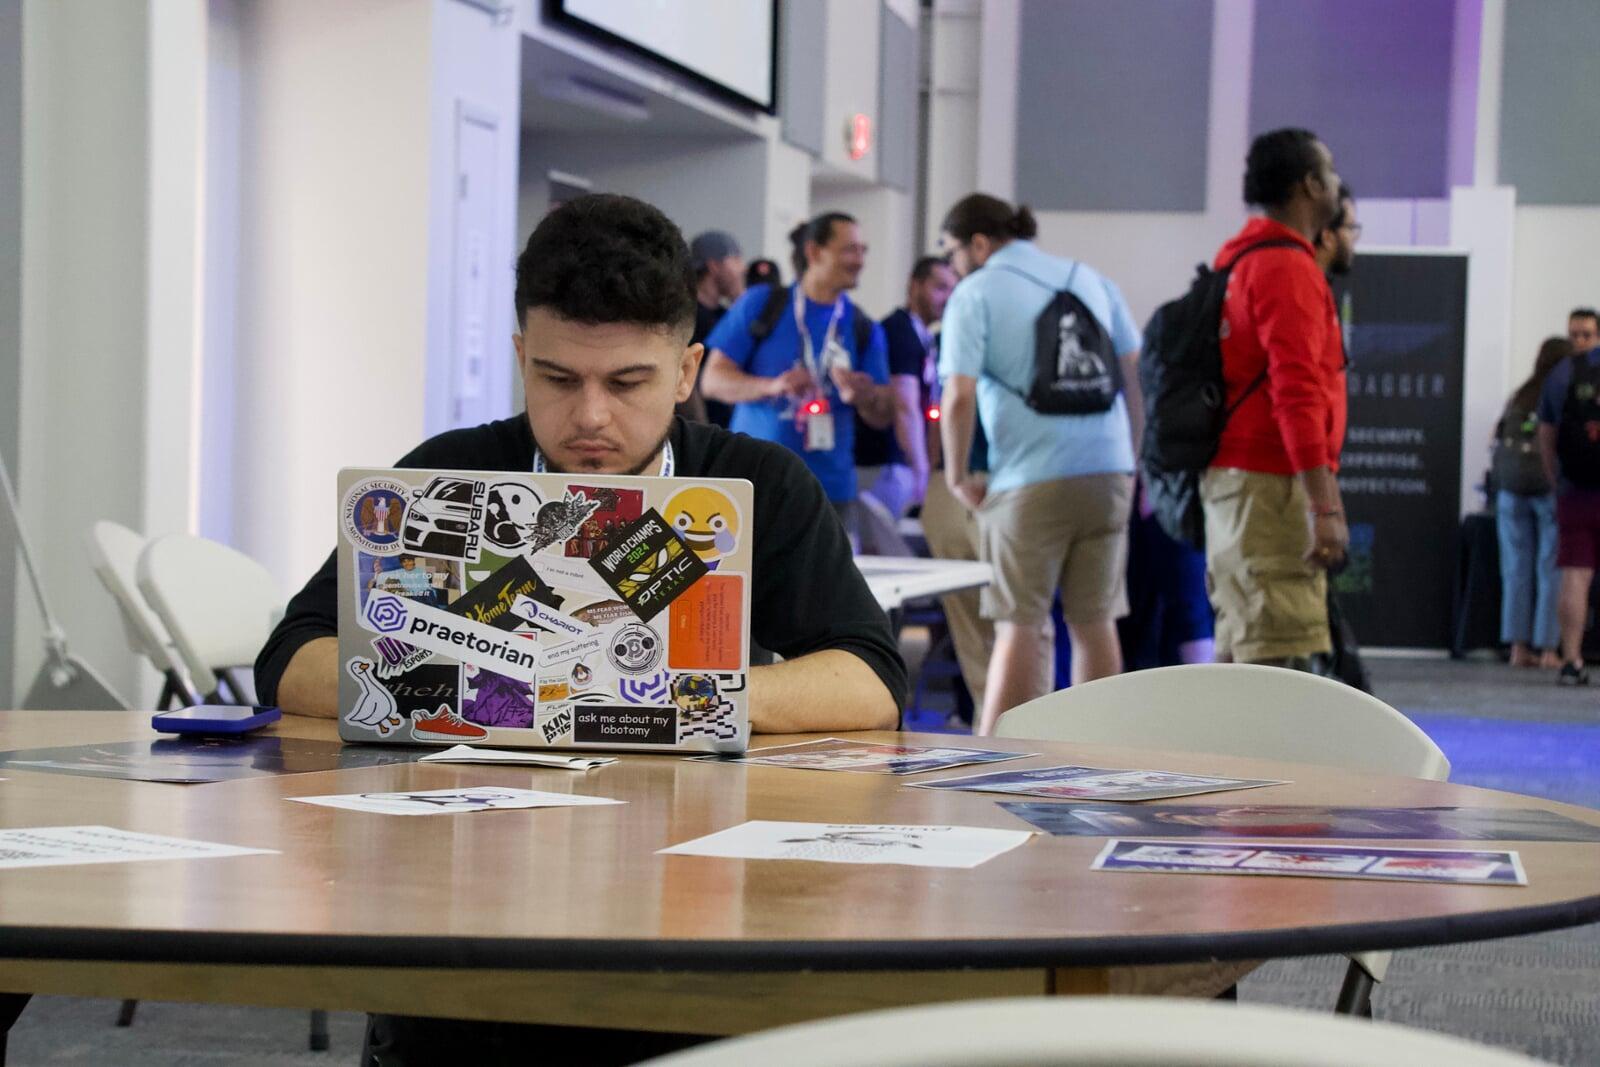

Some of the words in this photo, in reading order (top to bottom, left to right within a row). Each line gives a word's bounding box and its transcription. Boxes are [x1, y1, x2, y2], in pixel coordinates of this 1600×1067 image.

[346, 486, 369, 519] NATIONAL
[370, 482, 405, 495] SECURITY
[465, 480, 486, 560] SUBARU
[601, 542, 630, 573] WORLD
[626, 519, 663, 548] CHAMPS
[626, 542, 650, 564] 2024
[637, 556, 693, 606] OPTIC
[538, 612, 583, 635] CHARIOT
[409, 617, 535, 669] praetorian
[547, 651, 559, 660] end
[571, 639, 600, 653] suffering
[404, 649, 433, 669] ESPORTS
[578, 713, 597, 723] ask
[600, 715, 616, 723] me
[620, 714, 650, 724] about
[653, 716, 669, 727] my
[600, 724, 651, 738] lobotomy
